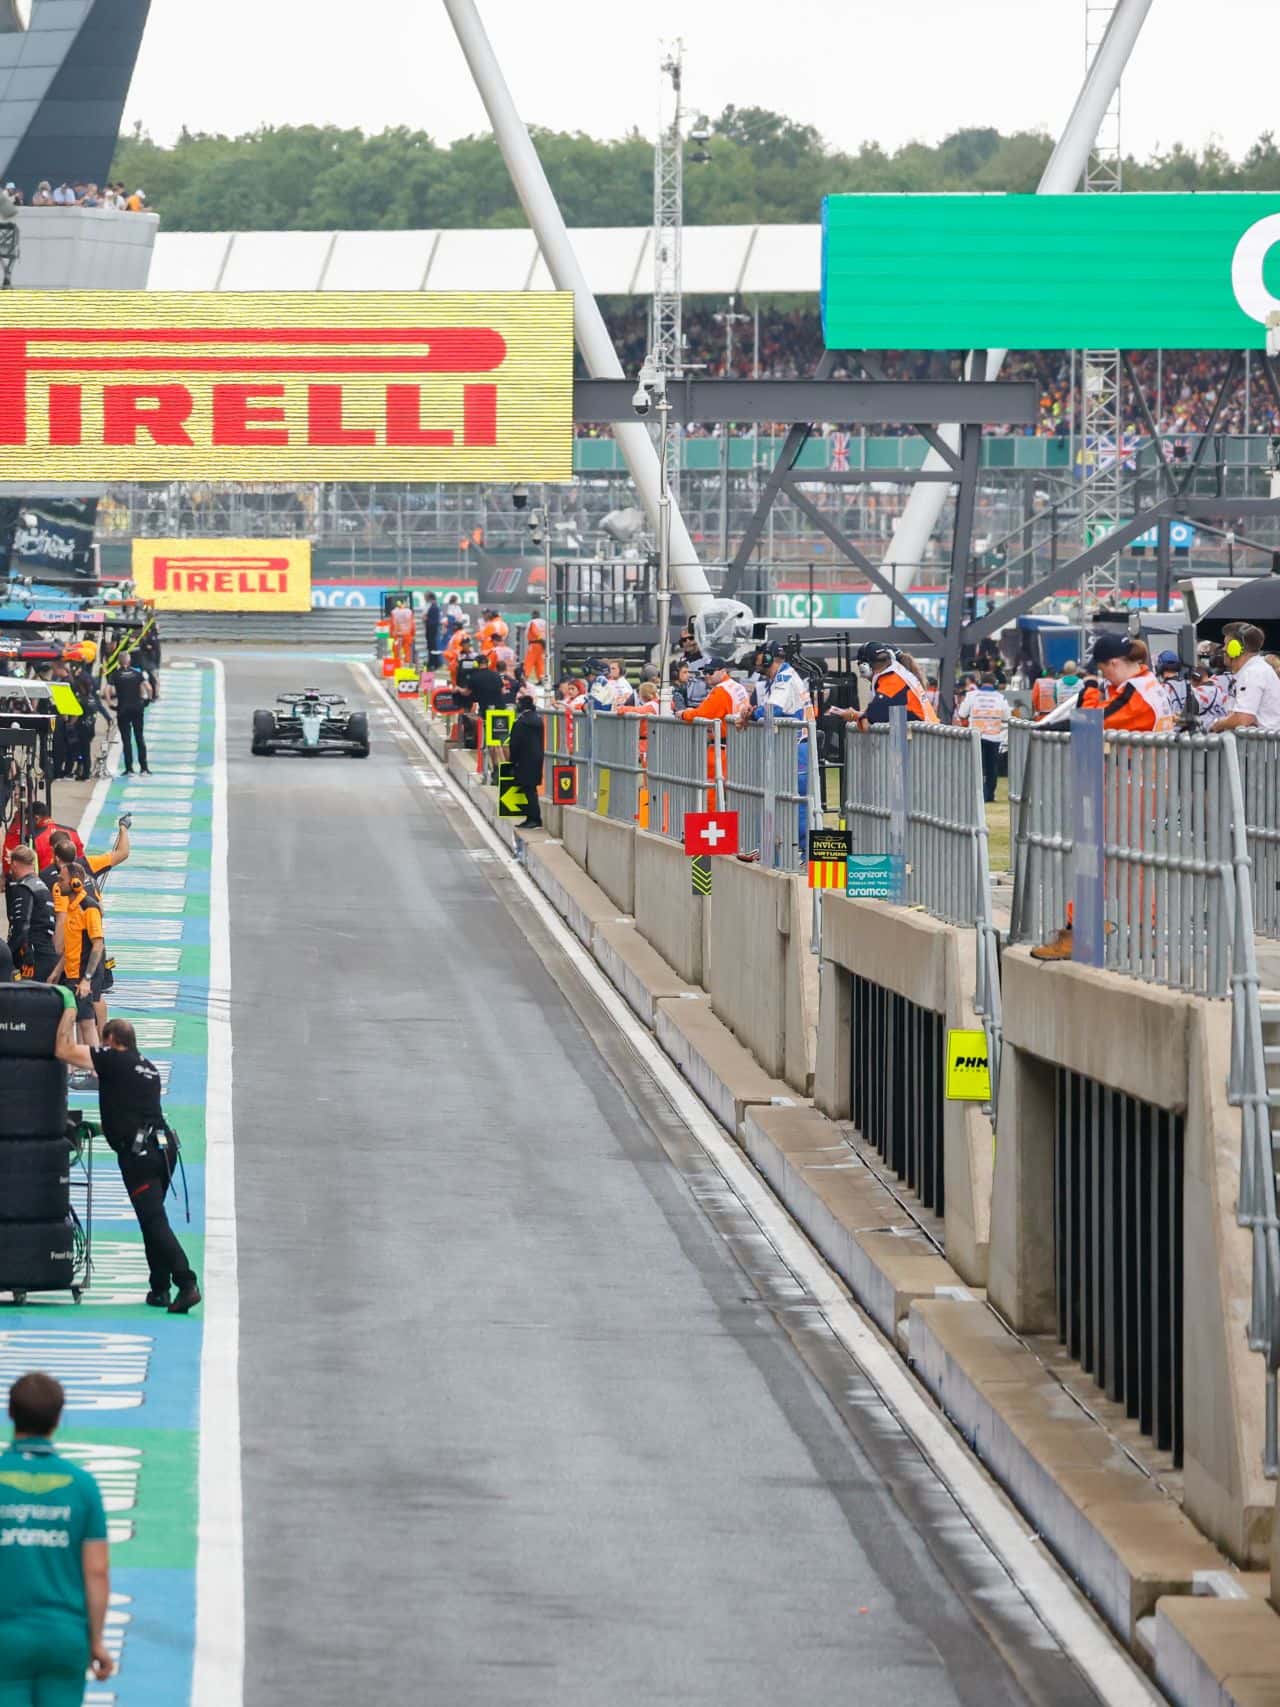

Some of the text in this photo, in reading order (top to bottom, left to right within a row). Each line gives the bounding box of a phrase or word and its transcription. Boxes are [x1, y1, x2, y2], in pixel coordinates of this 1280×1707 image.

[152, 556, 290, 593] PIRELLI
[813, 841, 847, 849] INVICTA
[848, 871, 888, 880] cognizant
[848, 888, 888, 896] aramco
[9, 1021, 27, 1032] Left
[955, 1056, 988, 1068] PHM
